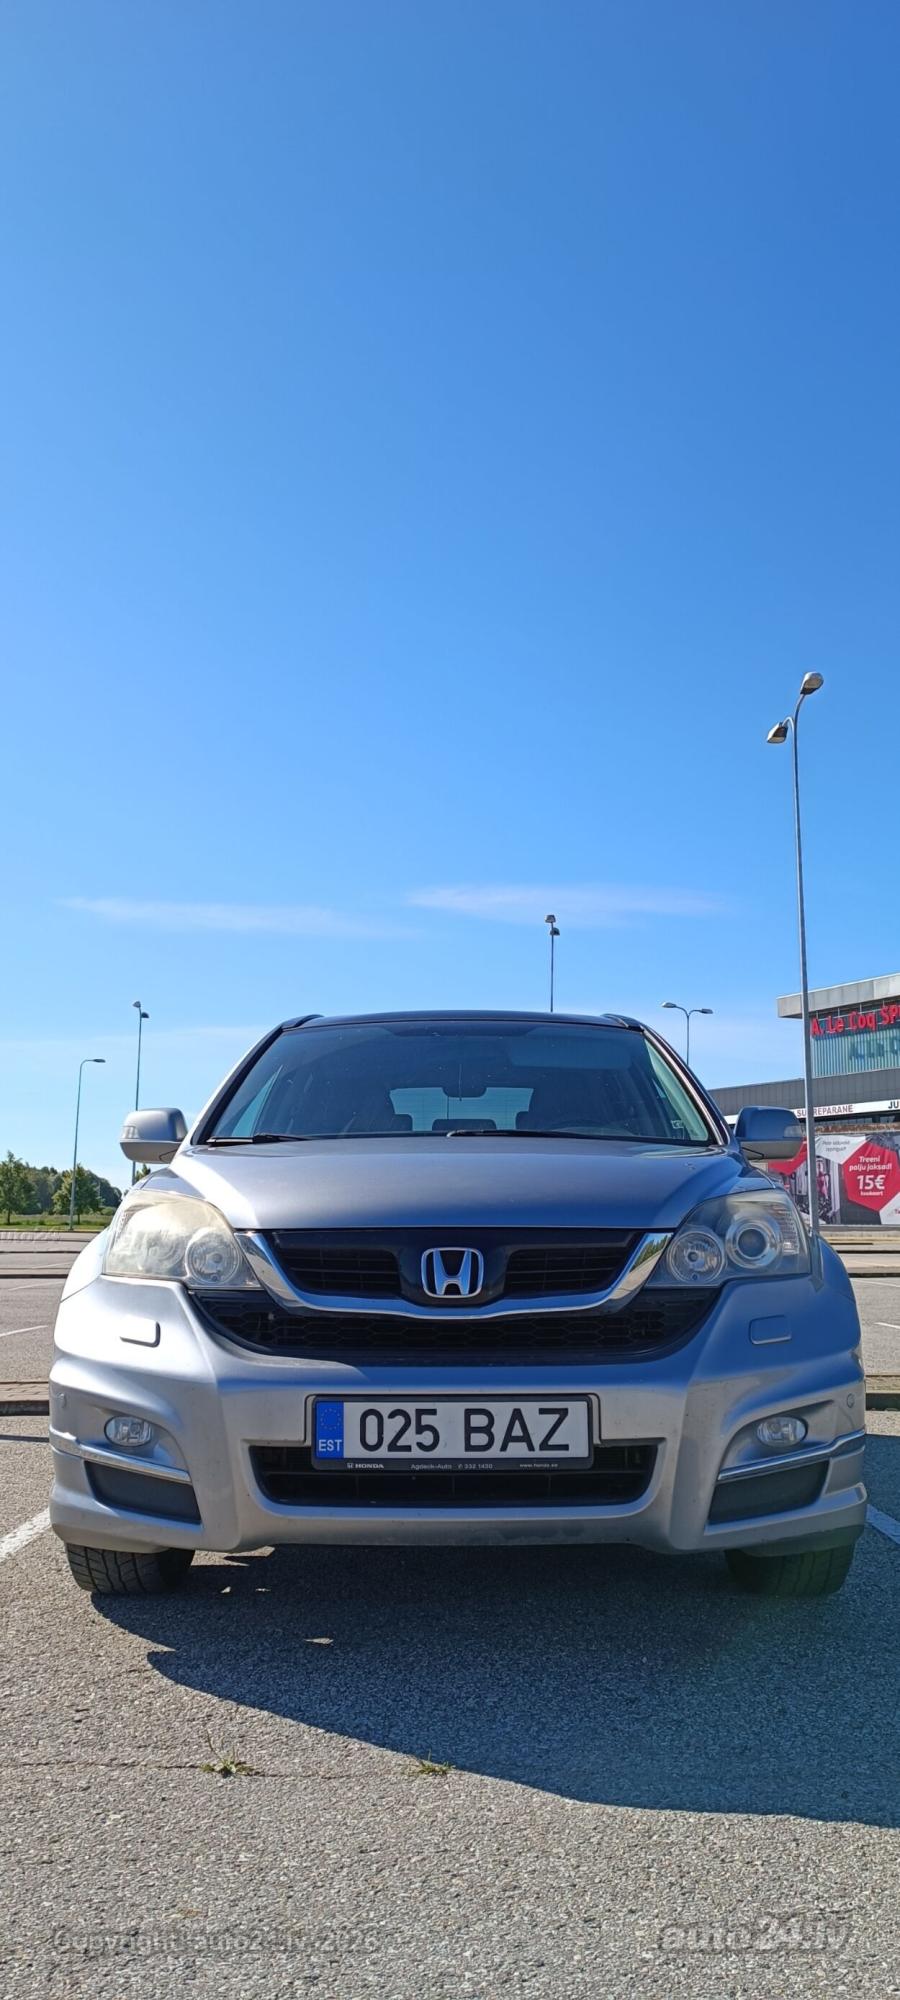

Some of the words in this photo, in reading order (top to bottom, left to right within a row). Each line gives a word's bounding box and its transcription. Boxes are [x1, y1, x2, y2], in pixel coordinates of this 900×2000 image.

[826, 1015, 845, 1034] Le
[848, 1010, 876, 1032] Coq
[857, 1174, 886, 1190] 15€
[360, 1408, 440, 1453] 025
[464, 1408, 569, 1453] BAZ
[318, 1439, 342, 1452] EST
